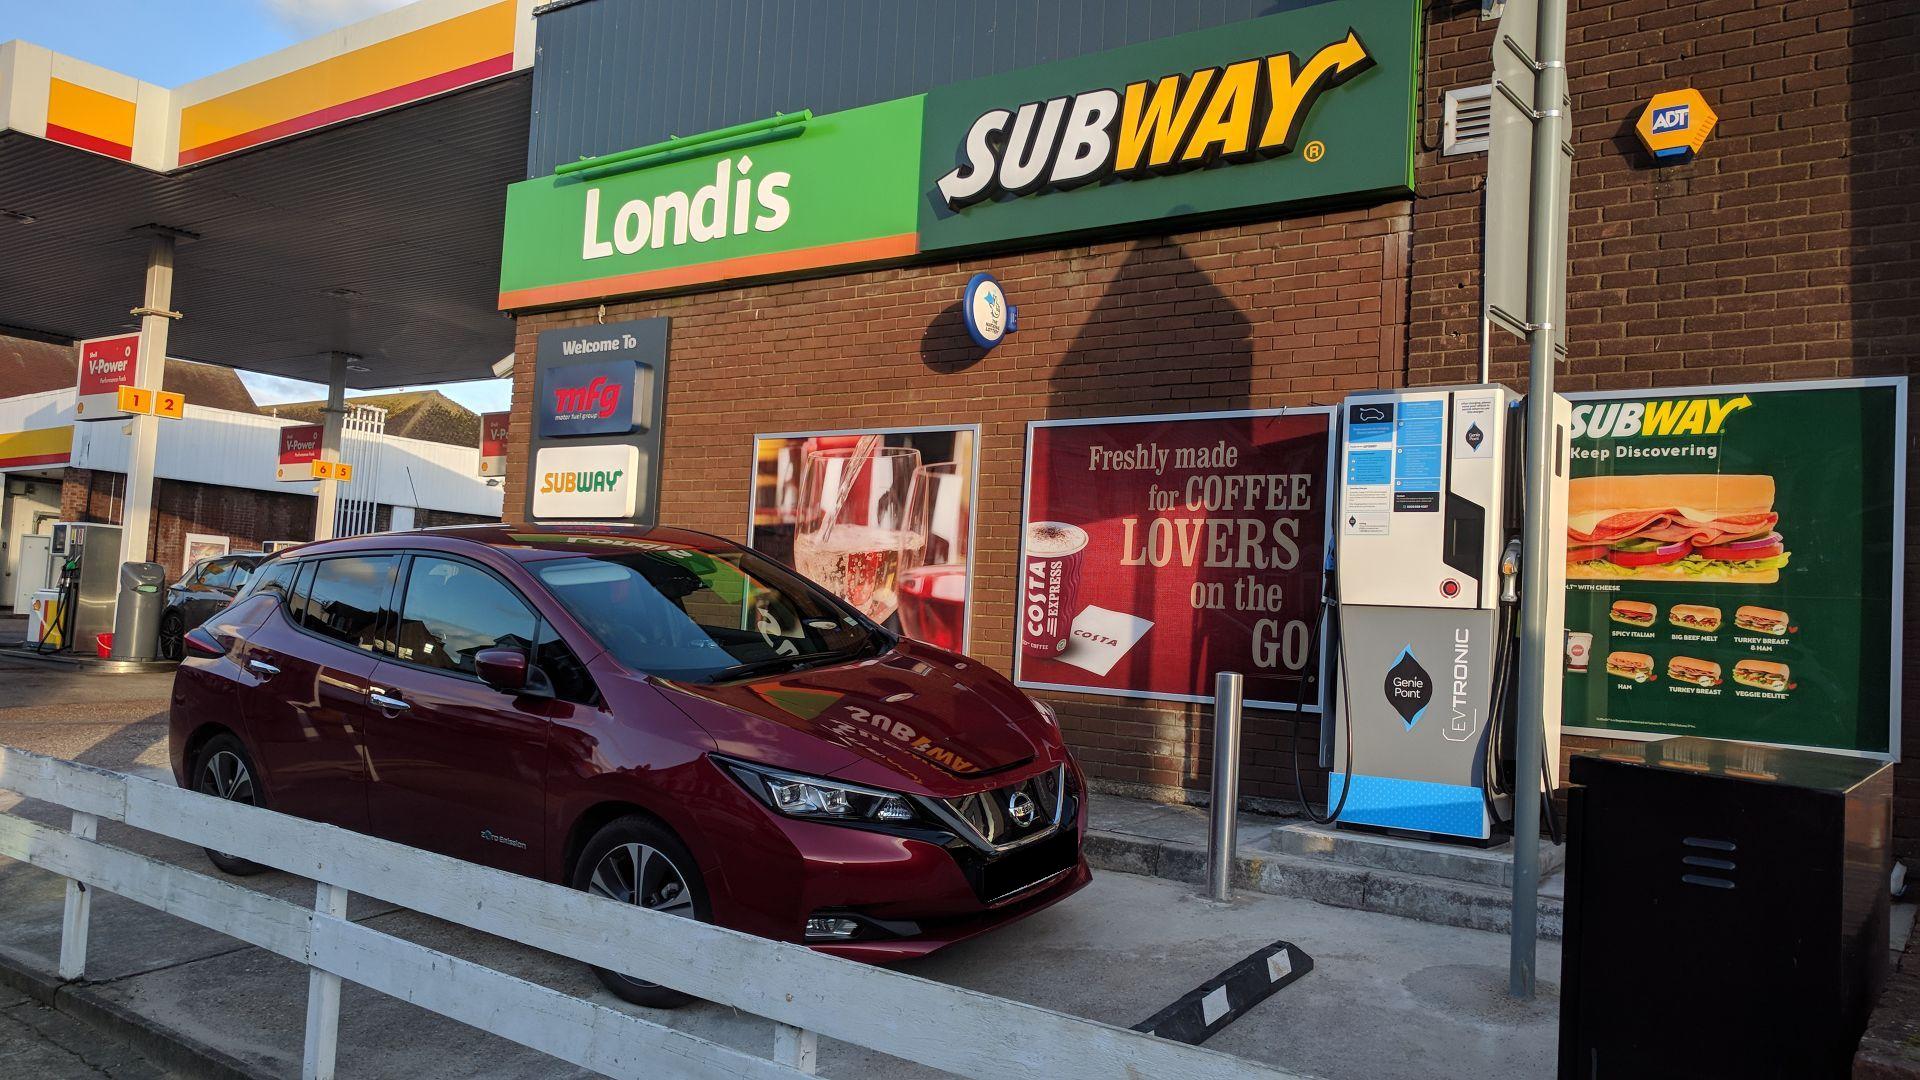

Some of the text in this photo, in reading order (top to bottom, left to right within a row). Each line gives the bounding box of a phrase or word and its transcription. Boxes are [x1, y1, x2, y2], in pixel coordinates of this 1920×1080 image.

[937, 28, 1376, 211] SUBWAY
[1653, 109, 1689, 130] ADT
[582, 155, 791, 260] Londis
[562, 334, 636, 356] Welcome To
[89, 359, 128, 375] V-Power
[134, 394, 140, 406] 1
[164, 399, 174, 410] 2
[554, 376, 622, 418] mfg
[1571, 394, 1752, 440] SUBWAY
[287, 440, 316, 450] V-Power
[1088, 440, 1238, 475] Freshly made
[1570, 444, 1717, 461] Keep Discovering
[320, 466, 326, 474] 6
[340, 468, 346, 476] 5
[540, 469, 623, 494] SUBWAY
[1148, 484, 1179, 512] for
[1185, 474, 1311, 512] COFFEE
[1120, 517, 1300, 570] LOVERS
[1028, 562, 1046, 636] COSTA
[1048, 560, 1062, 616] EXPRESS
[1190, 575, 1283, 612] on the
[1074, 630, 1118, 646] COSTA
[1252, 618, 1308, 670] GO
[1393, 676, 1424, 689] Genie
[1452, 628, 1470, 731] EVTRONIC
[1394, 688, 1420, 699] Point
